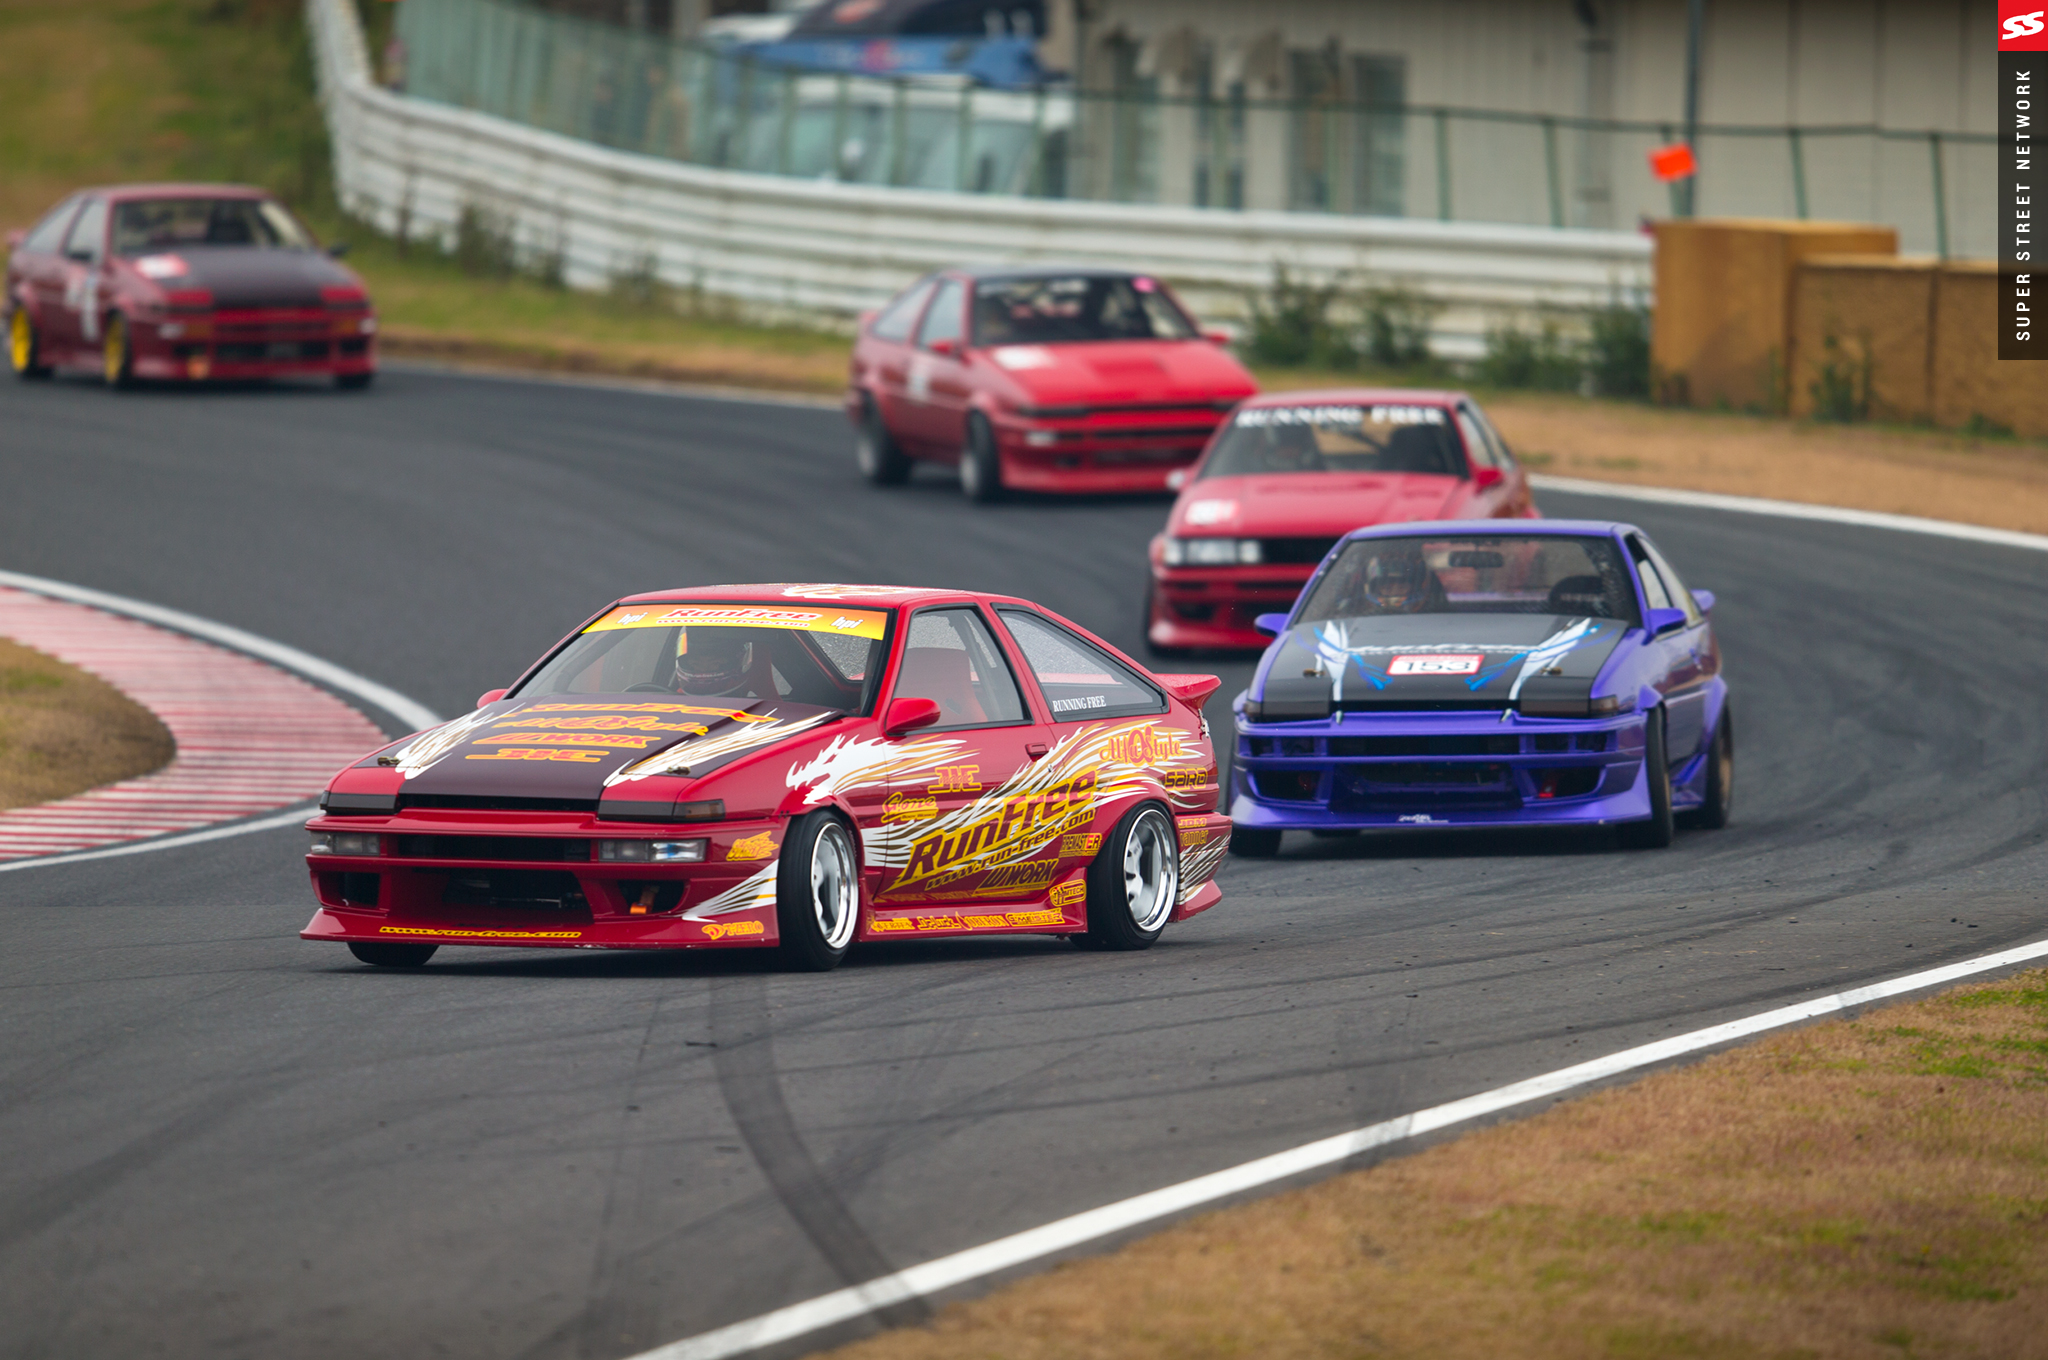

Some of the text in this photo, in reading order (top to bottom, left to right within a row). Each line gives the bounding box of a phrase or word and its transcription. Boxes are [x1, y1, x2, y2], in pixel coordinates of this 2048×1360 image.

[1236, 405, 1445, 427] RUNNING FREE
[617, 612, 649, 625] hpi
[660, 608, 824, 621] RunFree
[831, 616, 864, 630] hpi
[1407, 660, 1471, 671] 153
[1052, 695, 1107, 712] RUNNING FREE
[898, 766, 1100, 886] RunFree
[1178, 817, 1207, 829] JDM
[925, 806, 1096, 891] www.run-free.com
